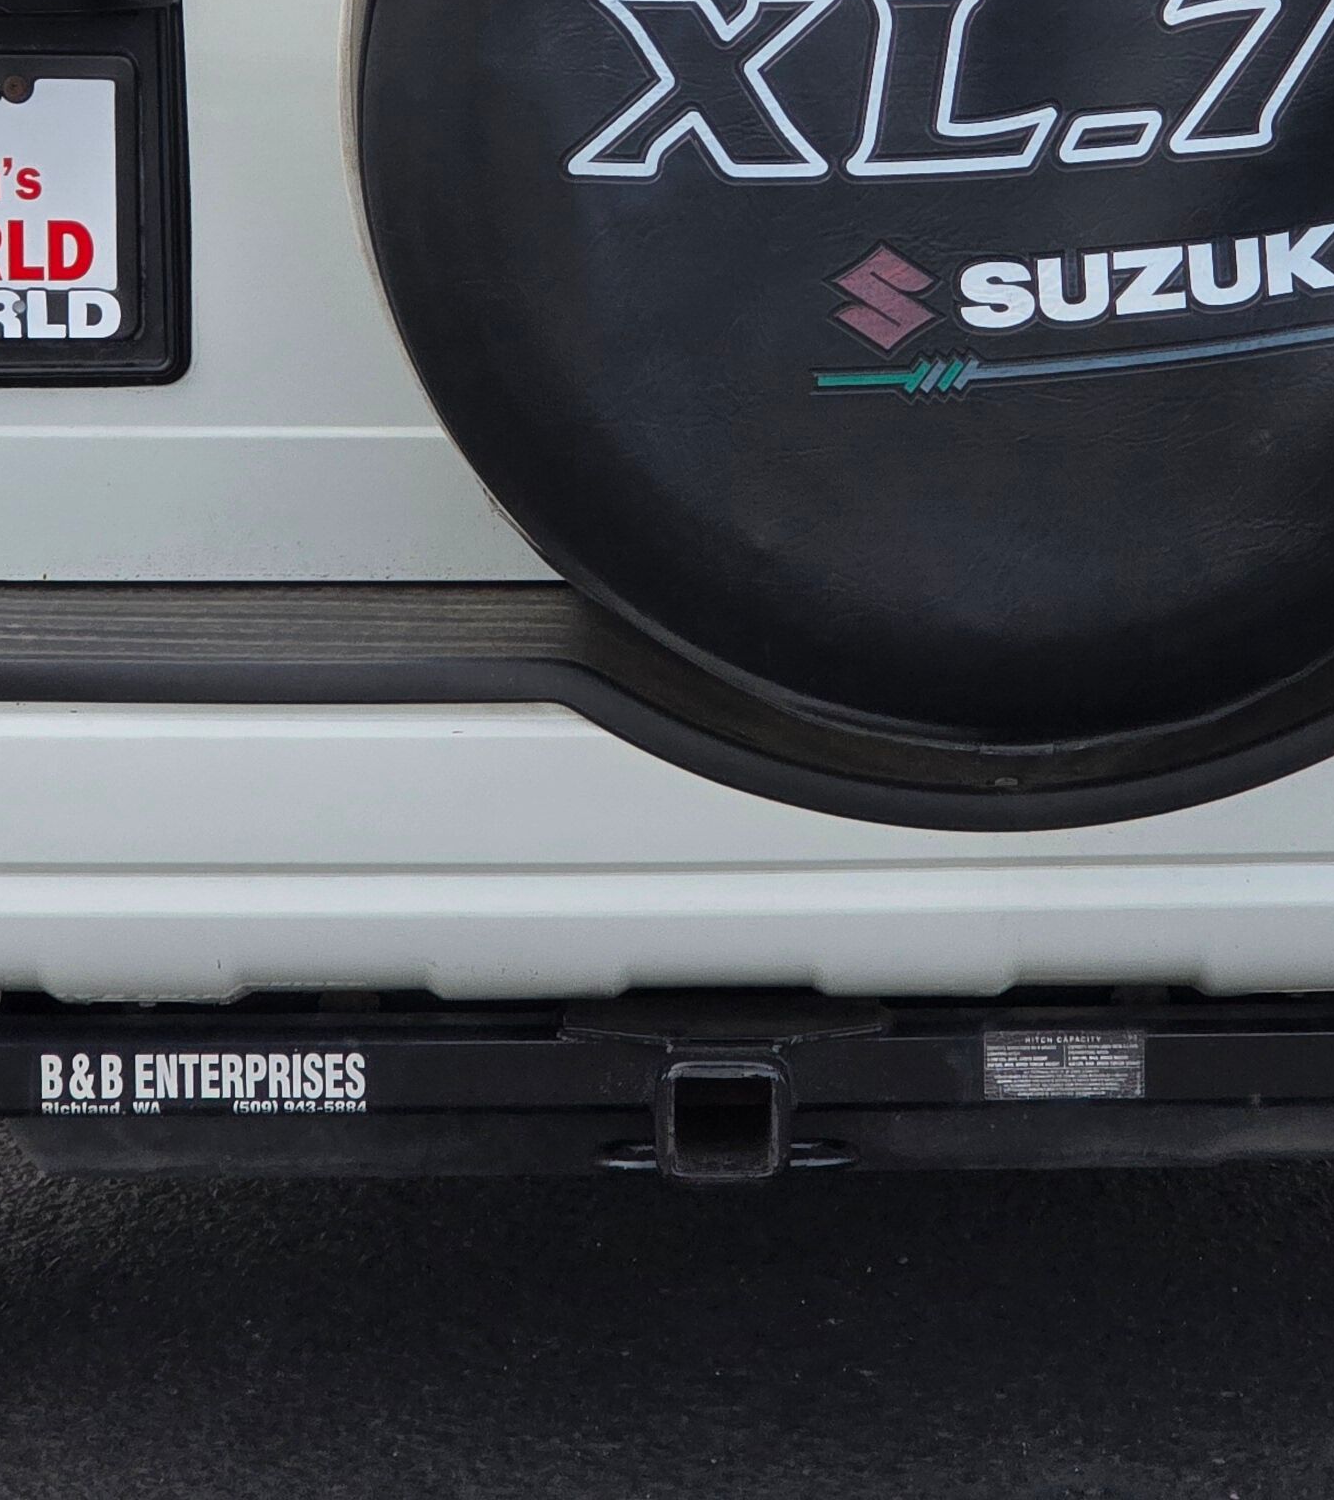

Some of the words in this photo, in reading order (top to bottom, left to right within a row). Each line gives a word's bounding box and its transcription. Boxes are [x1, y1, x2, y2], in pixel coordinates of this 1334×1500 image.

[1024, 1036, 1053, 1044] HITCH
[1055, 1035, 1102, 1044] CAPACITY
[134, 1052, 367, 1100] ENTERPRISES
[132, 1101, 161, 1115] WA
[232, 1100, 279, 1115] (509)
